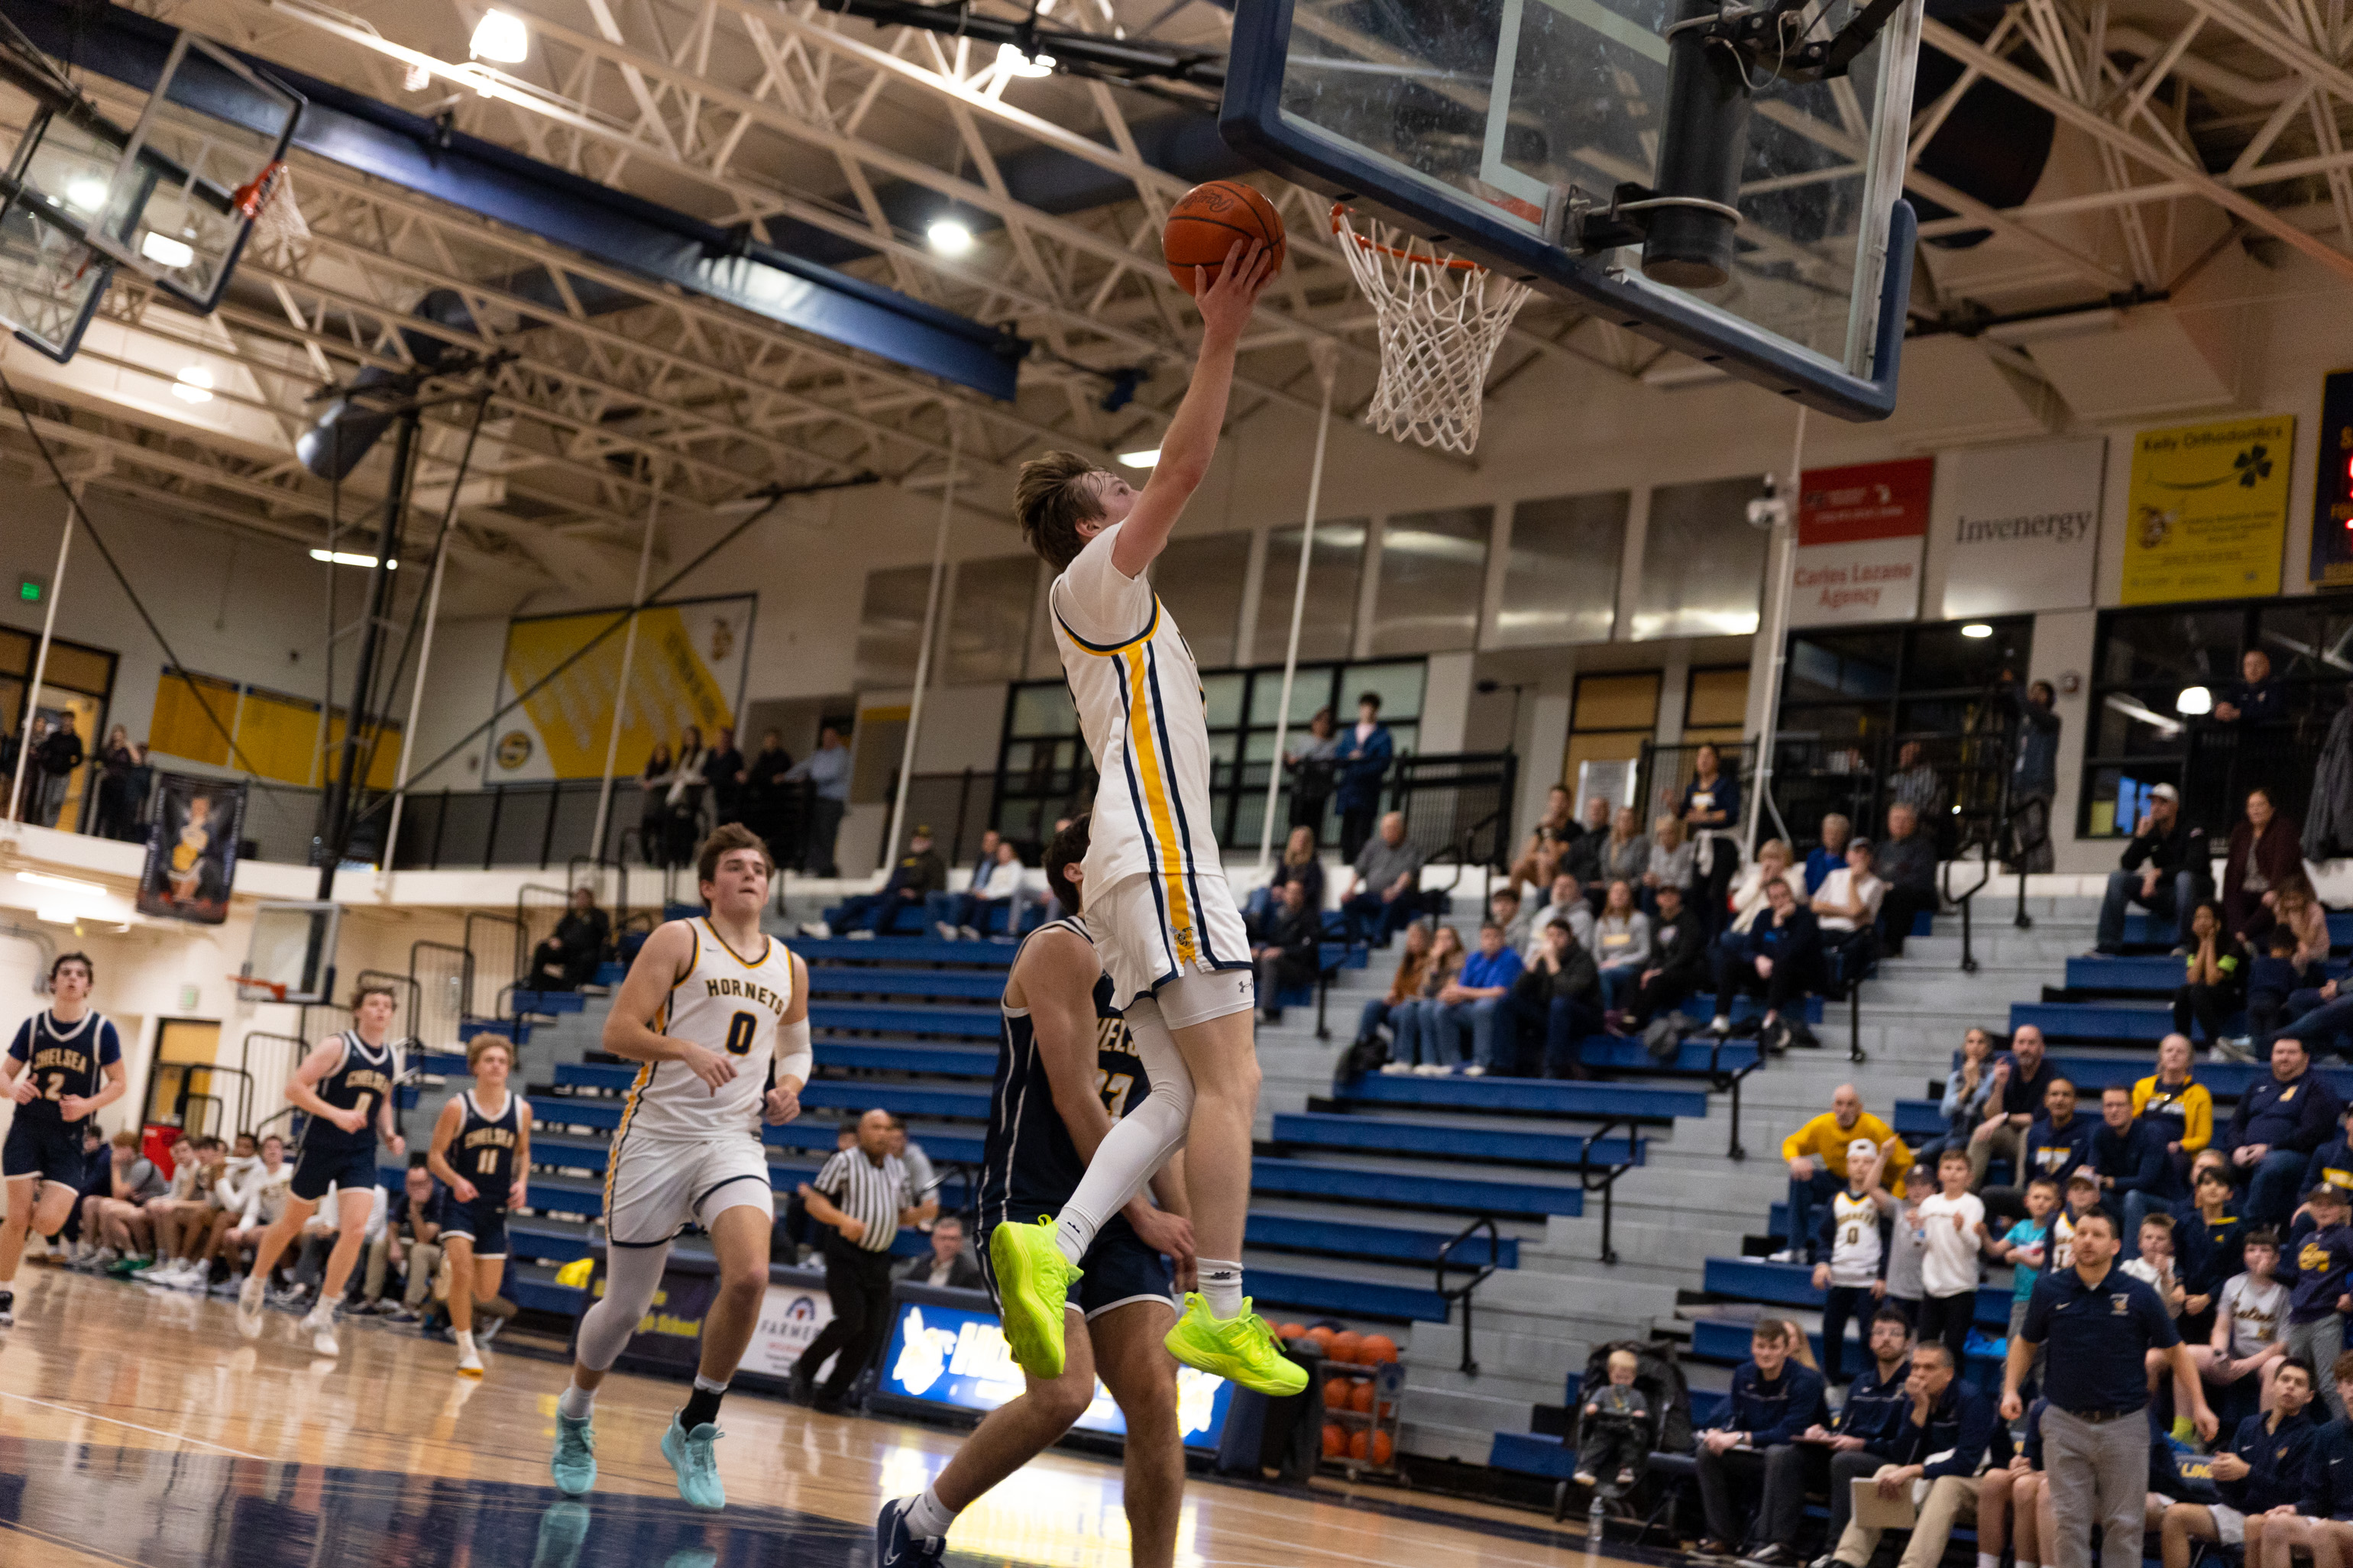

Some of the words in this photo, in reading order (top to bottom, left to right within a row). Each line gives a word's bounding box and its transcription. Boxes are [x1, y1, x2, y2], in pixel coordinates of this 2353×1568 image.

[1956, 510, 2093, 545] Invenergy
[1818, 586, 1882, 609] Agency
[704, 978, 784, 1016] HORNETS
[725, 1009, 758, 1057] 0
[33, 1047, 87, 1074] CHELSEA
[44, 1072, 66, 1101] 2
[477, 1148, 499, 1175] 11
